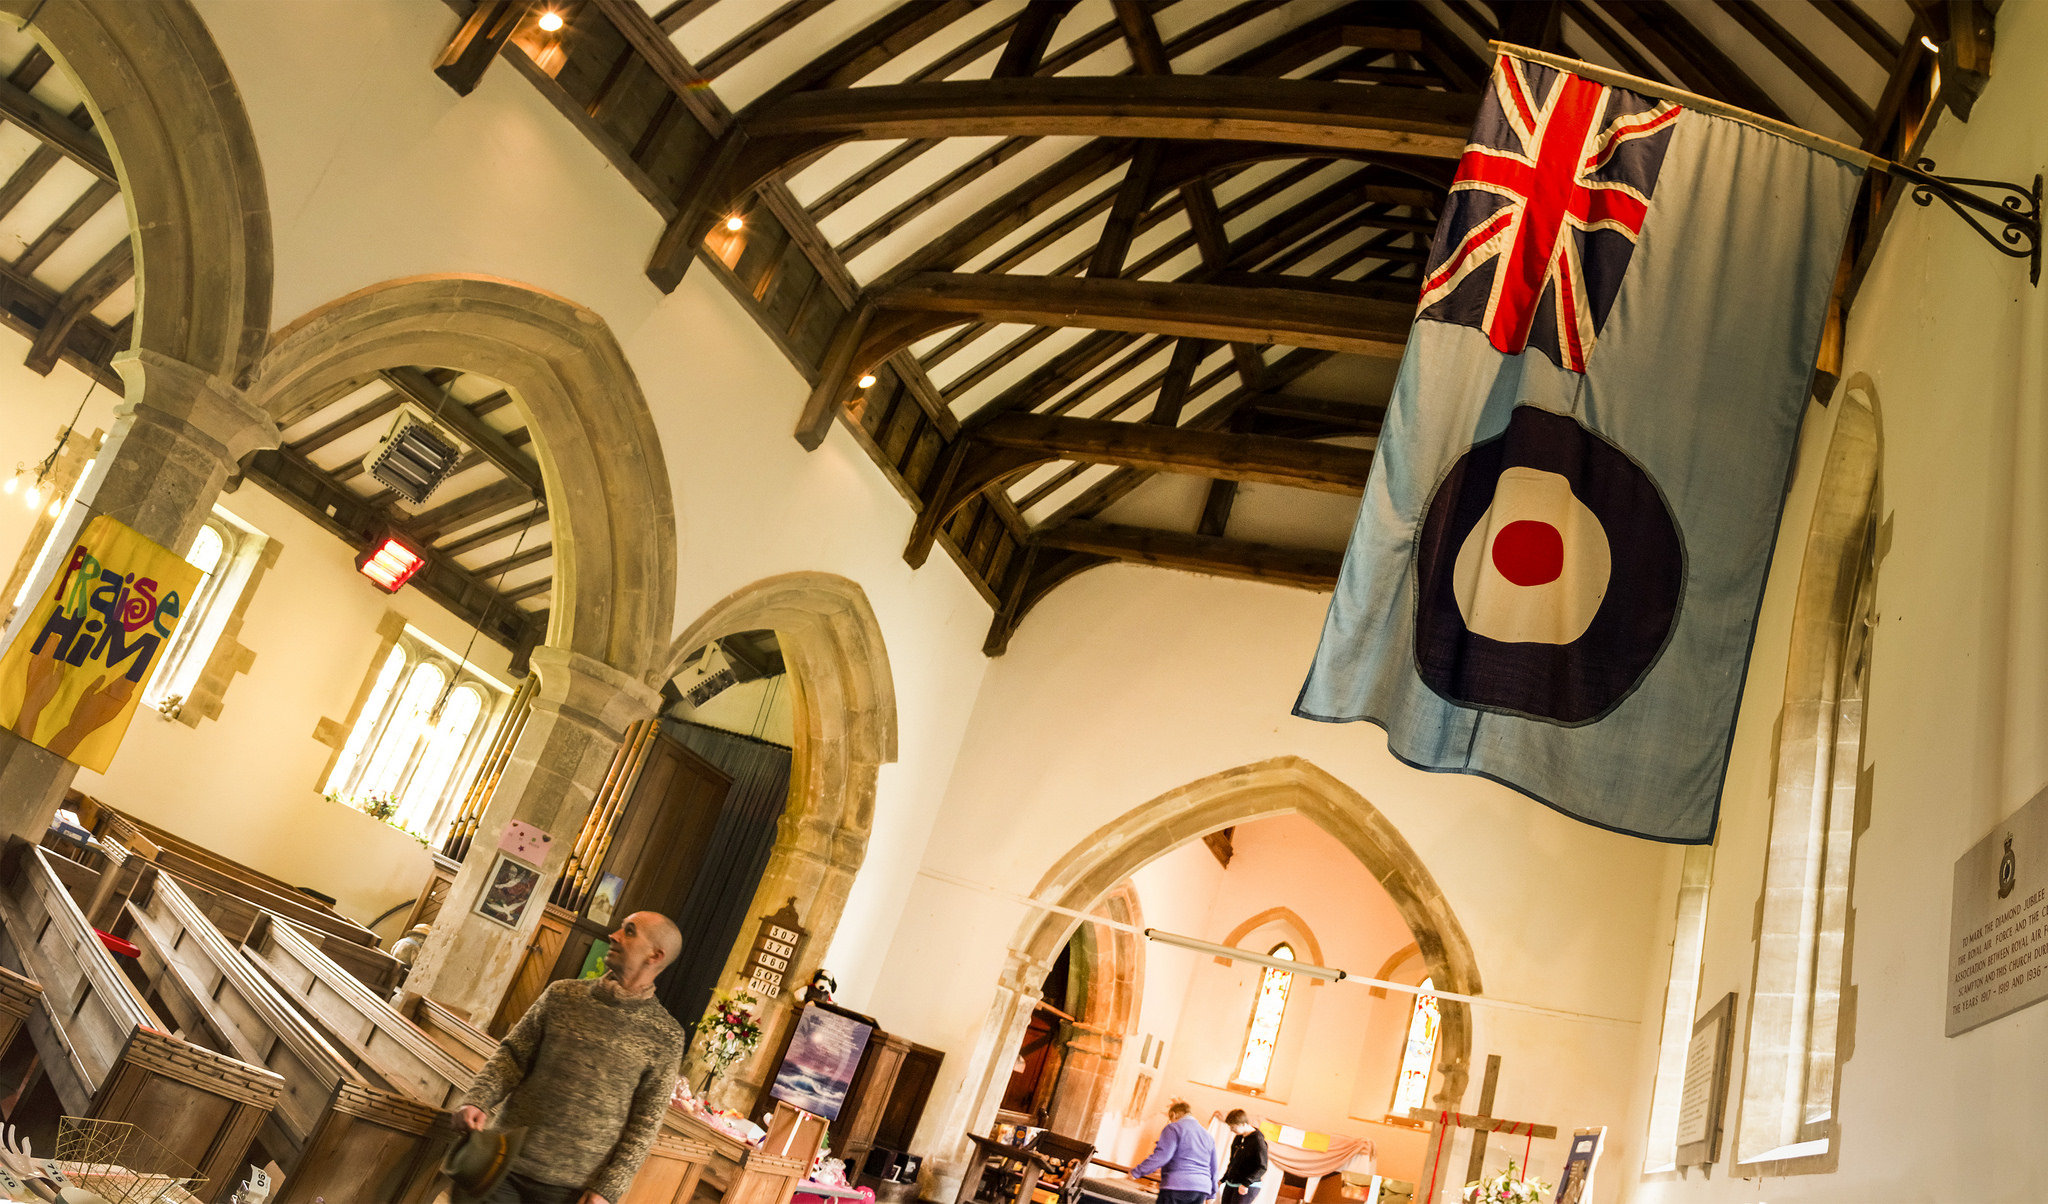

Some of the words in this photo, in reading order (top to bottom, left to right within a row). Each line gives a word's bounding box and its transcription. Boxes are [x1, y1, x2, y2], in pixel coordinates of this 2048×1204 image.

[1962, 937, 1969, 949] TO
[1969, 928, 1983, 944] MARK
[1984, 921, 1994, 935] THE
[1995, 904, 2021, 928] DIAMOND
[2023, 888, 2045, 911] JUBILEE
[772, 928, 796, 943] 307
[1958, 954, 1966, 966] THE
[1967, 945, 1982, 961] ROYAL
[1984, 939, 1992, 952] AIR
[1995, 927, 2013, 944] FORCE
[2015, 918, 2027, 934] AND
[2028, 910, 2040, 925] THE
[767, 942, 791, 956] 376
[1954, 959, 1986, 983] ASSOCIATION
[1987, 946, 2010, 967] BETWEEN
[2011, 936, 2029, 954] ROYAL
[2031, 928, 2042, 944] AIR
[761, 954, 785, 970] 660
[756, 969, 779, 983] 502
[1958, 976, 1984, 997] SCAMPTON
[1984, 971, 1995, 985] AND
[1996, 964, 2008, 979] THIS
[2008, 951, 2032, 972] CHURCH
[751, 980, 777, 996] 416
[1952, 1003, 1961, 1016] THE
[1962, 995, 1978, 1012] YEARS
[1998, 980, 2010, 995] 1919
[2011, 974, 2024, 989] AND
[2026, 965, 2042, 982] 1936
[48, 1163, 64, 1182] 715
